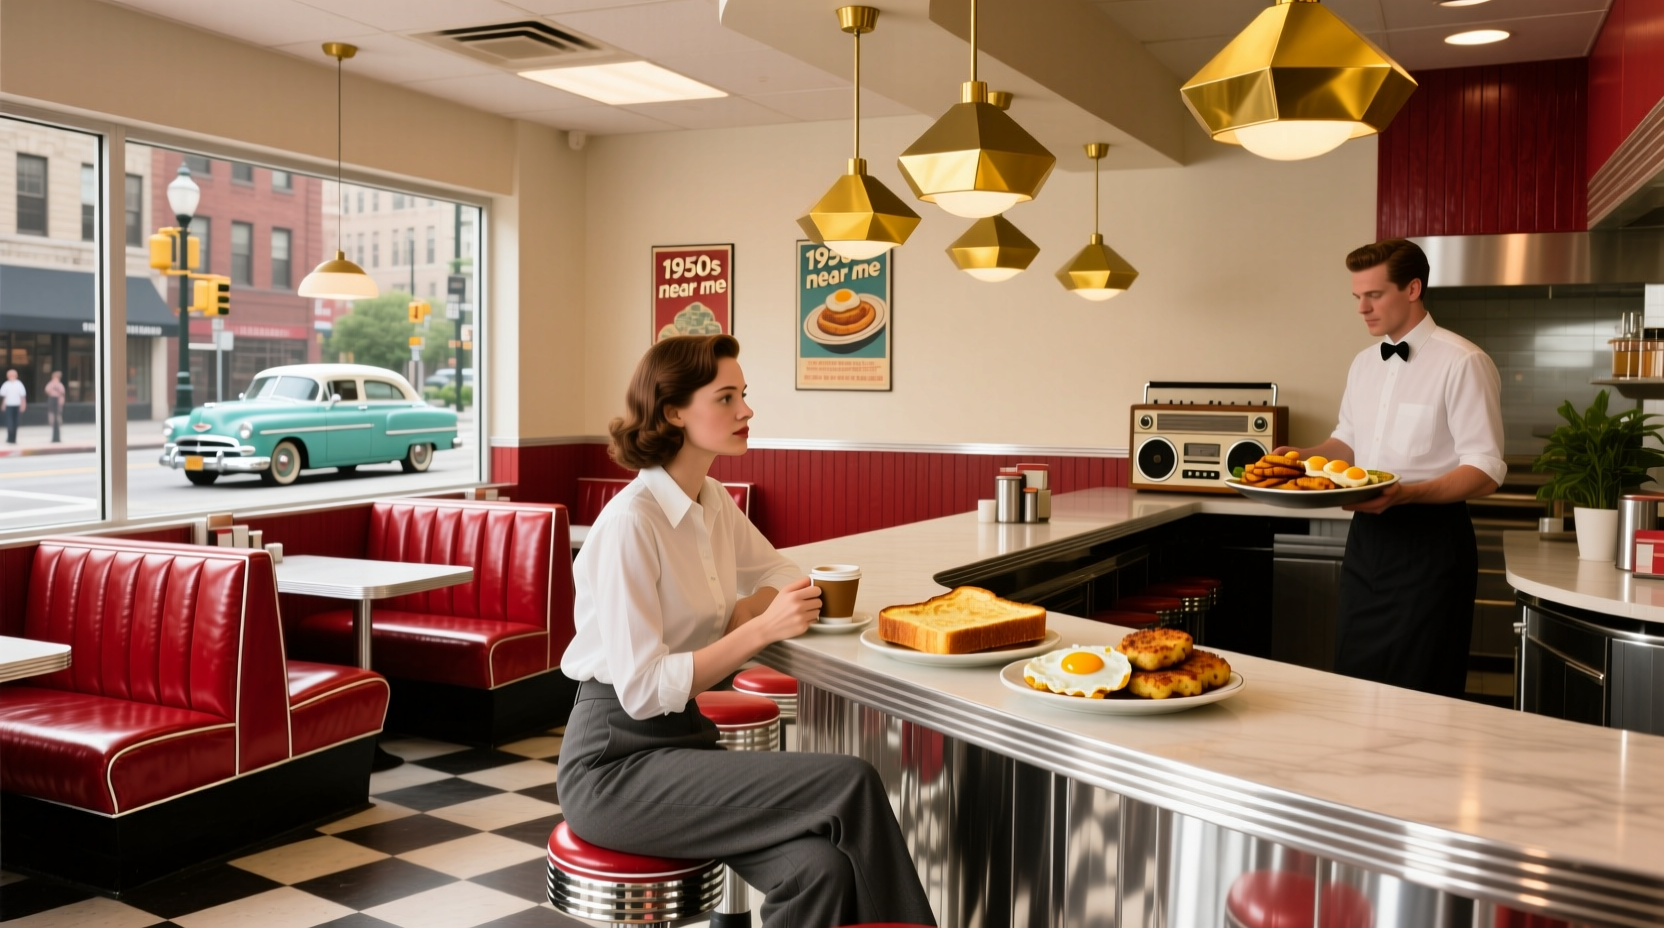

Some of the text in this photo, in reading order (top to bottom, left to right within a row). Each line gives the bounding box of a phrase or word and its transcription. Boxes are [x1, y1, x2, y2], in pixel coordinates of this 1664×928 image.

[663, 254, 722, 279] 1950s
[805, 261, 881, 289] near me
[658, 279, 727, 299] near me
